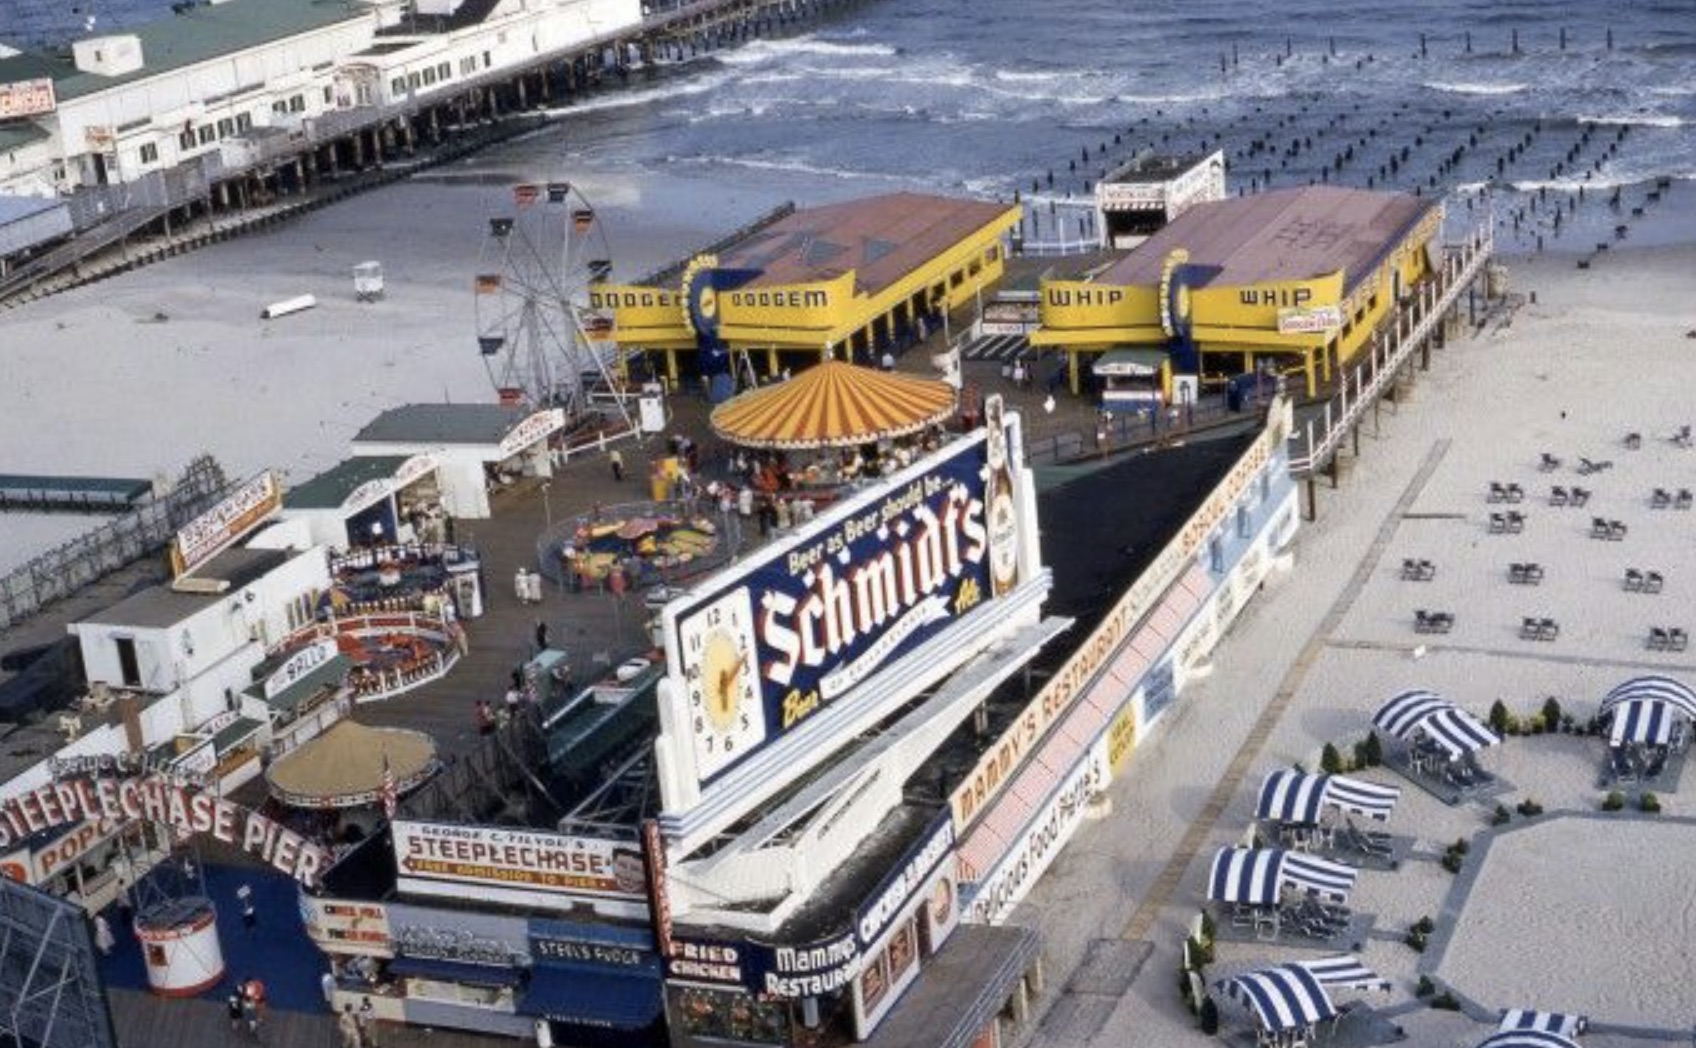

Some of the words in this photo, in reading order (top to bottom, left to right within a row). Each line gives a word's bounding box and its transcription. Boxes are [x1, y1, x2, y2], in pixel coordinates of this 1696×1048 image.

[731, 289, 829, 308] DODGEM
[1049, 289, 1124, 307] WHIP
[1239, 287, 1312, 306] WHIP
[788, 542, 824, 577] Beer
[844, 511, 879, 544] Beer
[760, 481, 987, 686] Schmidt's
[421, 826, 482, 840] GEORGE
[1029, 806, 1059, 864] Food
[244, 811, 322, 888] PIER
[408, 835, 605, 874] STEEPLECHASE
[669, 940, 739, 964] FRIED
[669, 959, 742, 982] CHICKEN
